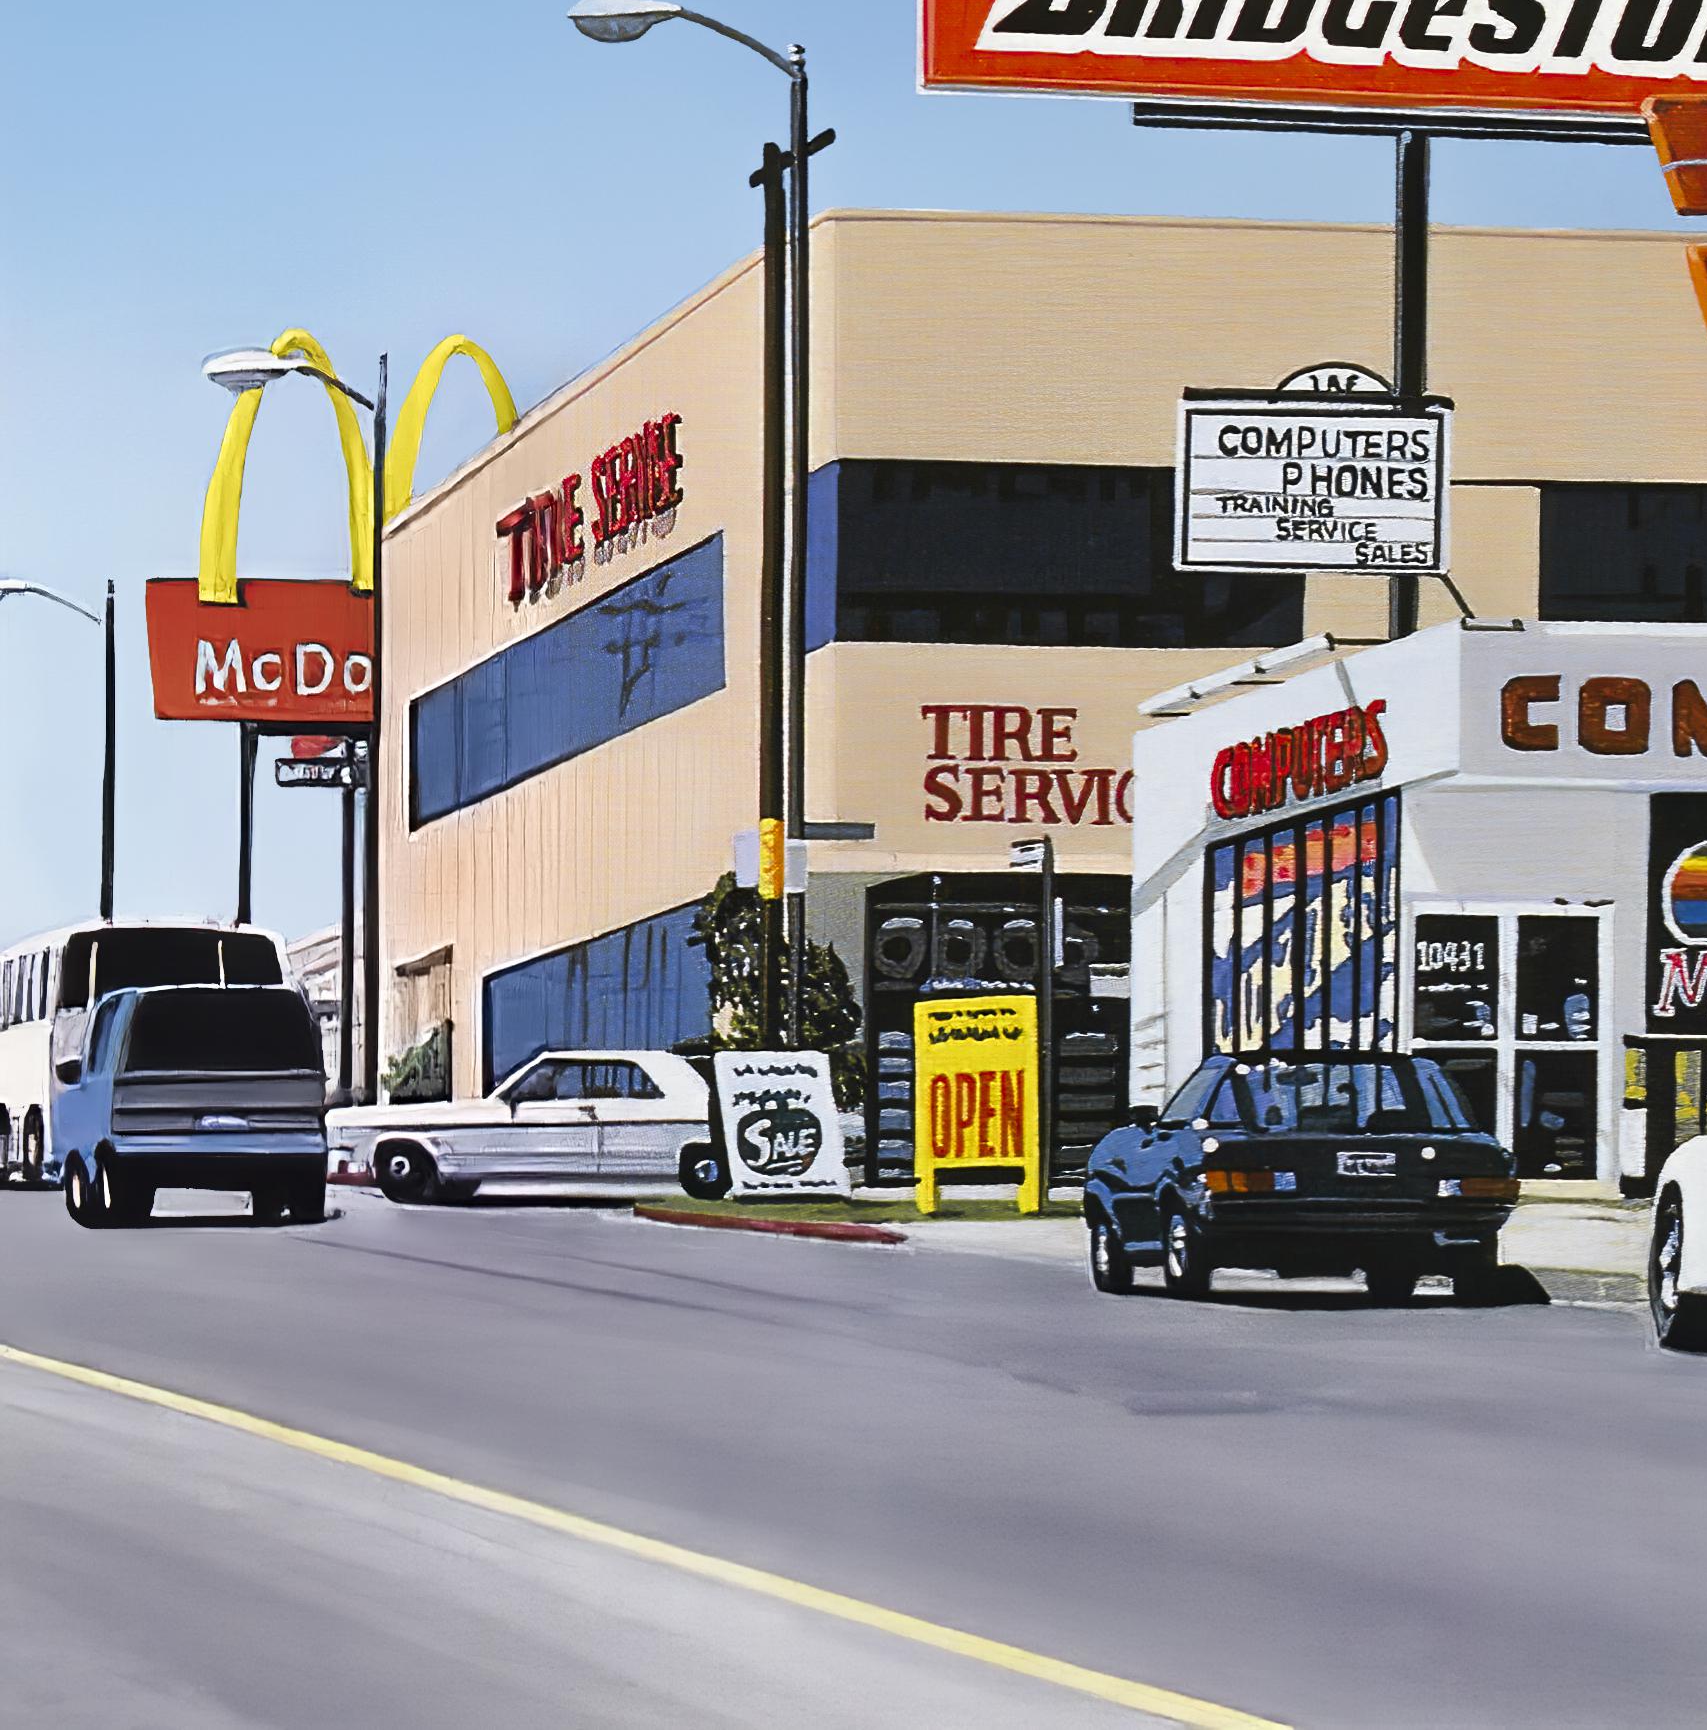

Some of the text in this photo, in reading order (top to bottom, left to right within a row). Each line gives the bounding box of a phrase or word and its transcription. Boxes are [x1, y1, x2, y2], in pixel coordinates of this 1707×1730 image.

[1217, 424, 1430, 463] COMPUTERS
[1283, 462, 1429, 500] PHONES
[1218, 493, 1334, 518] TRAINING
[1276, 516, 1378, 543] SERVICE
[1354, 541, 1428, 566] SALES
[195, 638, 373, 696] McDo
[921, 705, 1078, 763] TIRE
[1210, 699, 1388, 821] COMPUTERS
[1416, 940, 1486, 972] 10431
[931, 1070, 1026, 1158] OPEN
